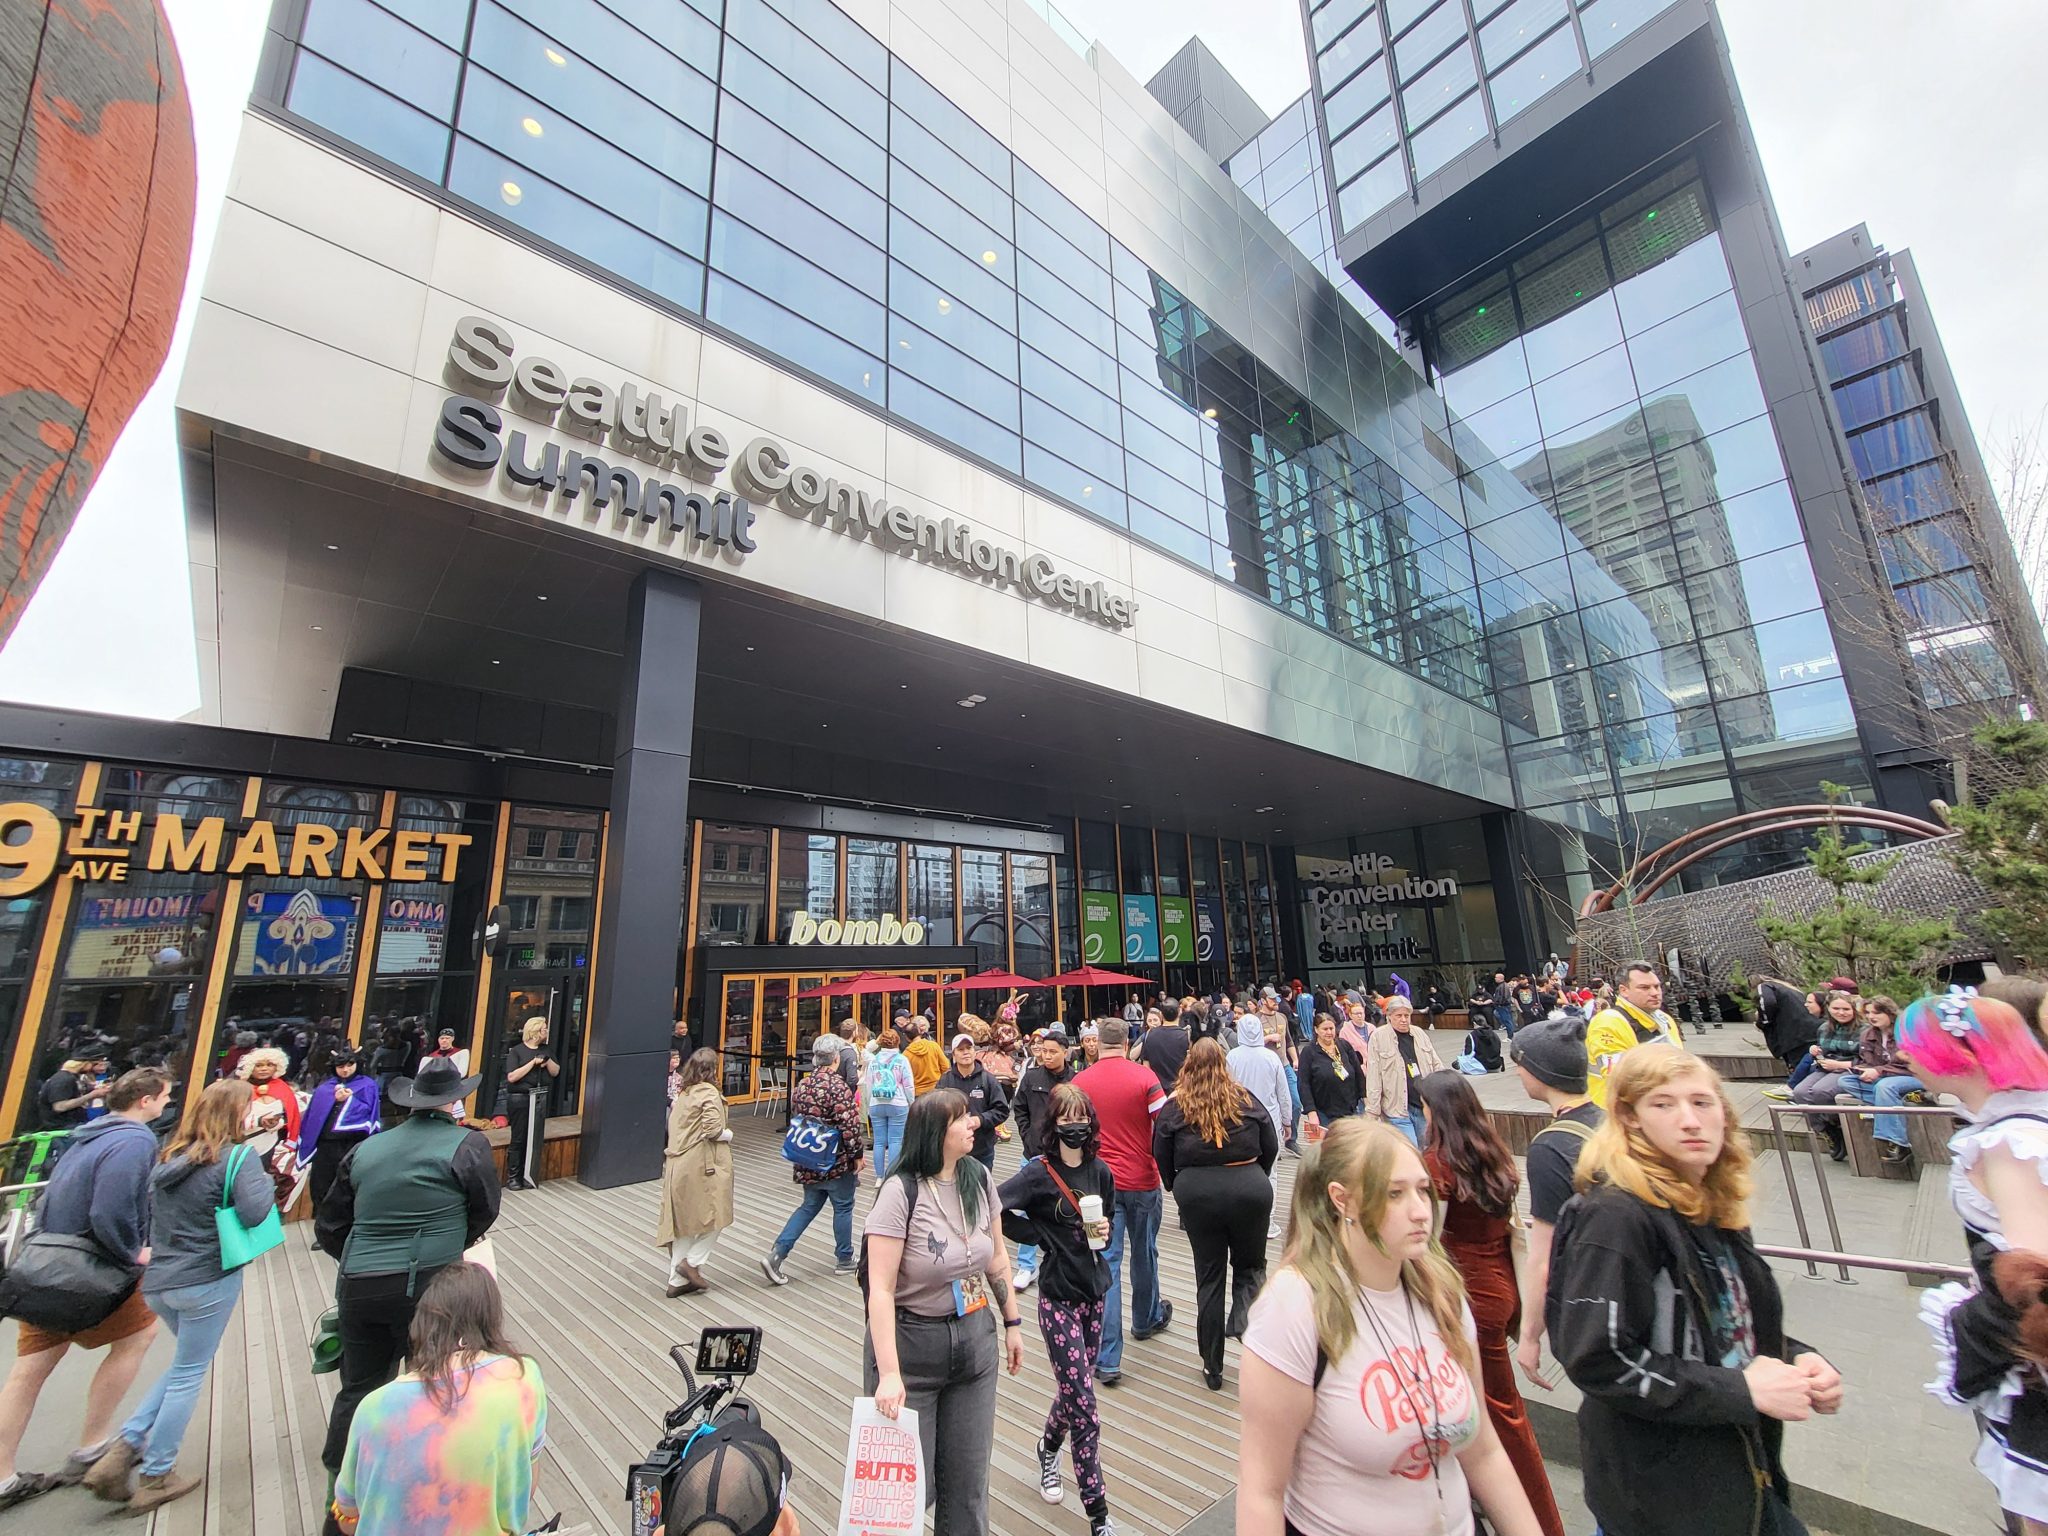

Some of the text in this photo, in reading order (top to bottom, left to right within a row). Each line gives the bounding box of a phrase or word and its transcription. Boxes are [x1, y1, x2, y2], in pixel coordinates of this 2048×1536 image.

[434, 395, 757, 553] Summit
[443, 316, 1140, 628] Seattle Convention Center
[147, 813, 472, 882] MARKET
[67, 860, 128, 881] AVE
[1310, 853, 1395, 881] Seattle
[1312, 876, 1457, 907] Convention
[789, 910, 923, 945] bombo
[1316, 910, 1398, 935] Center
[1318, 936, 1421, 964] Summit
[1391, 1345, 1430, 1388] Dr
[1361, 1350, 1460, 1433] Pepper
[859, 1426, 915, 1449] BUTTS
[857, 1443, 916, 1465] BUTTS
[854, 1460, 917, 1483] BUTTS
[853, 1480, 916, 1500] BUTTS
[850, 1497, 915, 1520] BUTTS
